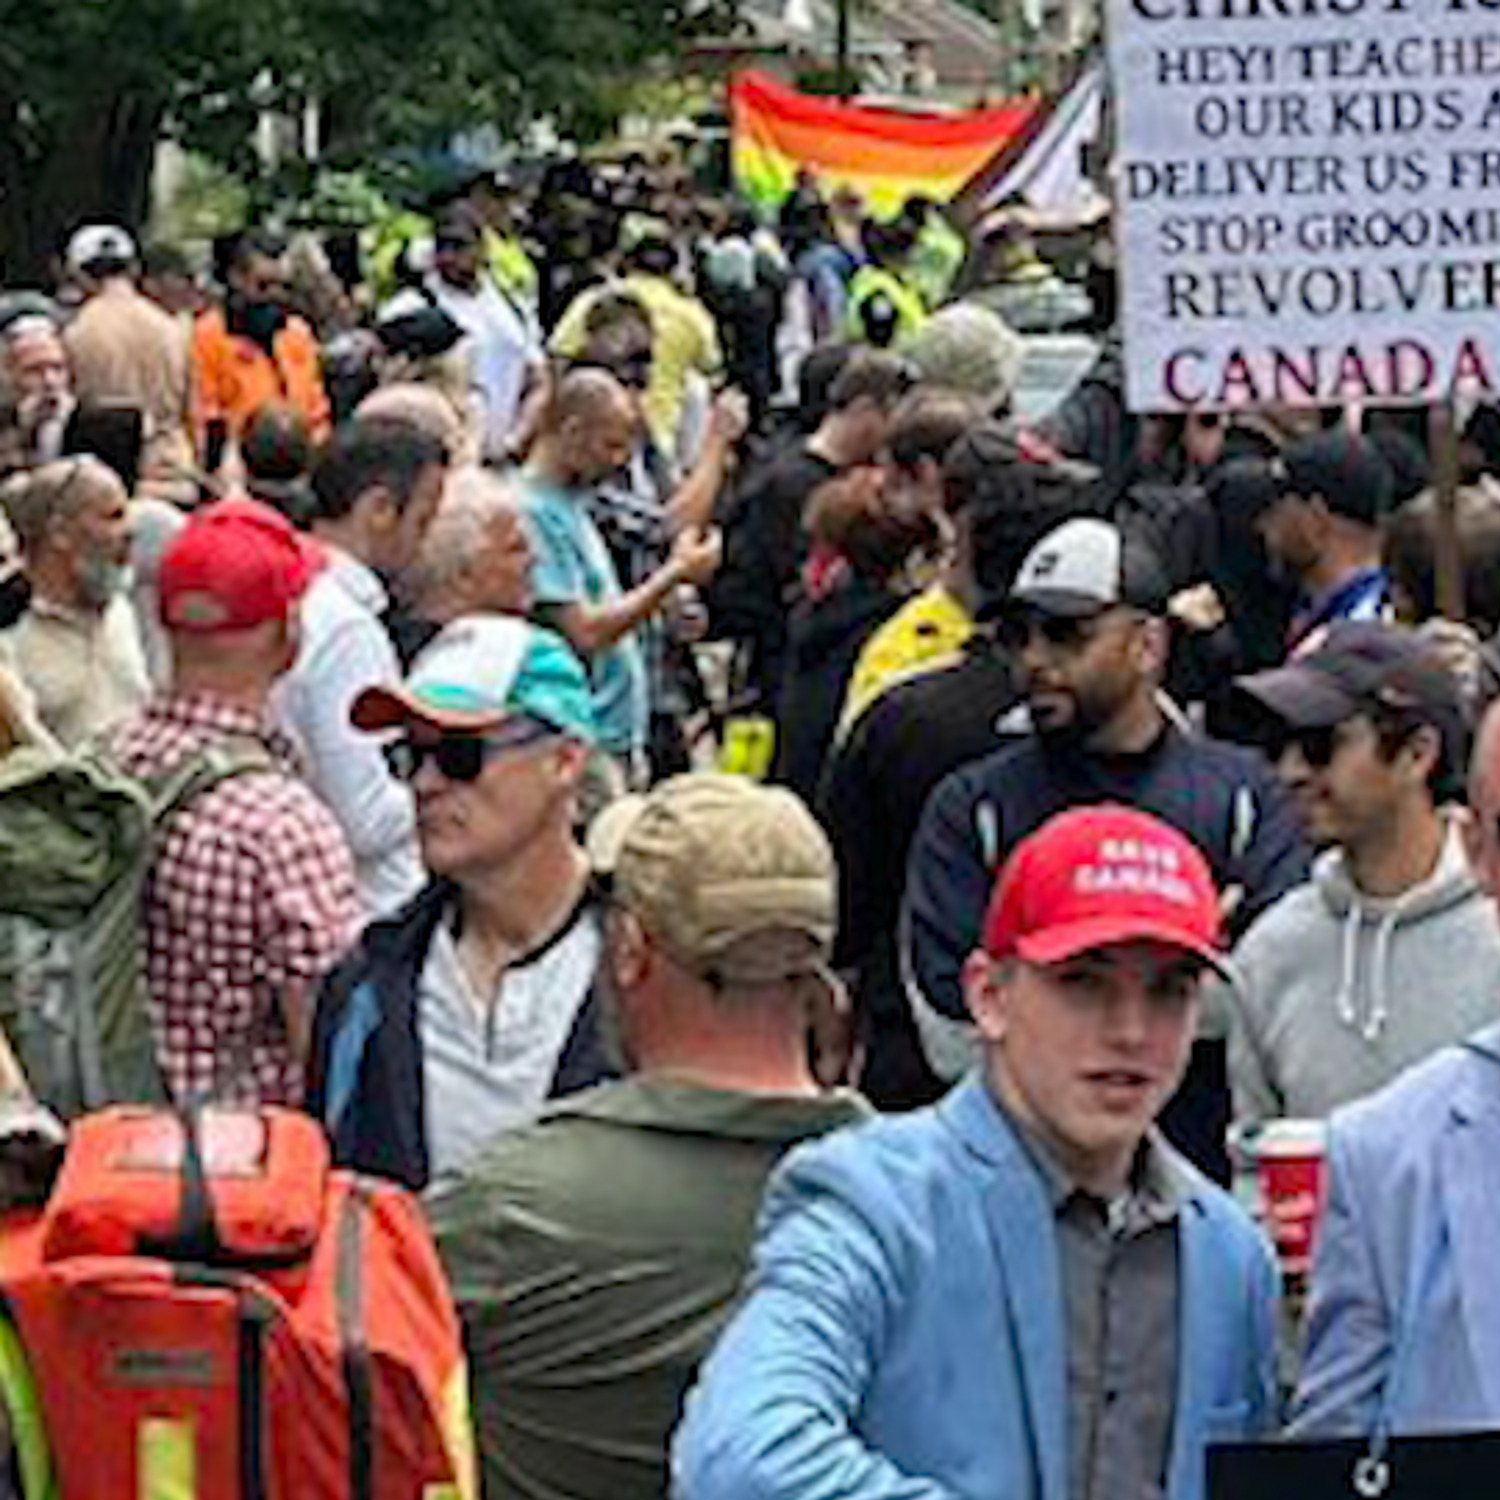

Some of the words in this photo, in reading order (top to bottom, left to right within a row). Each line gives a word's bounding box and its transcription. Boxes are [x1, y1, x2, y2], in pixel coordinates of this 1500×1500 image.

[1155, 44, 1275, 85] HEY!
[1195, 93, 1312, 140] OUR
[1330, 86, 1464, 136] KIDS
[1126, 152, 1347, 200] DELIVER
[1360, 147, 1430, 195] US
[1157, 212, 1284, 255] STOP
[1163, 336, 1494, 406] CANADA
